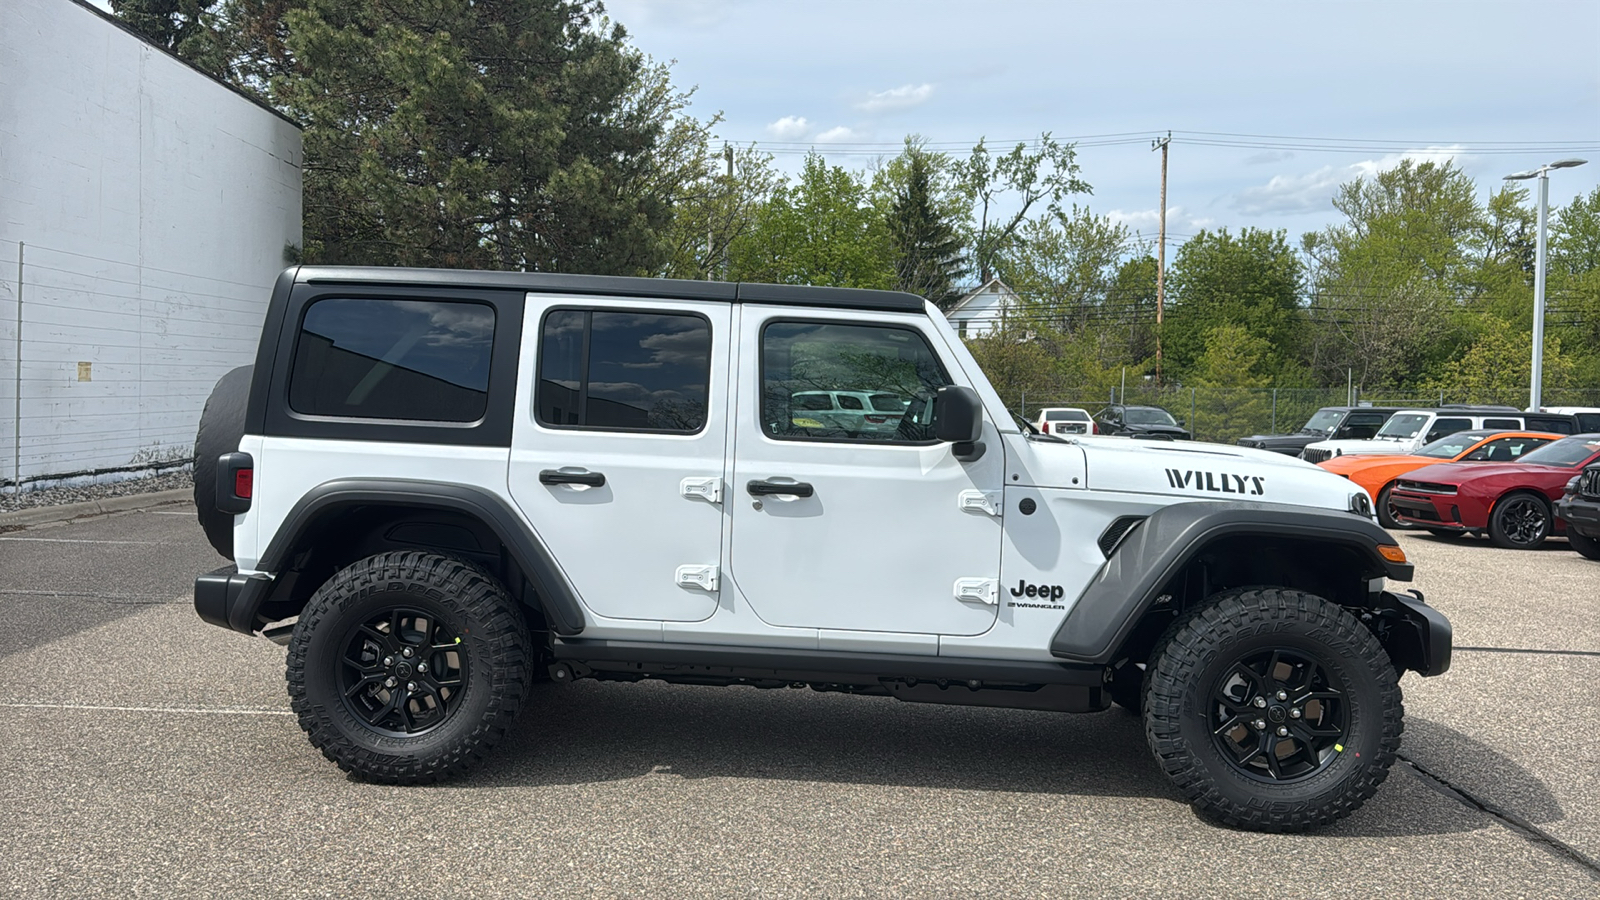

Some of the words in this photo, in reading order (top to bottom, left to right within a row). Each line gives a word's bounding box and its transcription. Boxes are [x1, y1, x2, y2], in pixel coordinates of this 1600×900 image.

[1165, 468, 1265, 495] WILLYS
[1010, 579, 1064, 602] Jeep
[1016, 602, 1065, 610] WRANGLER
